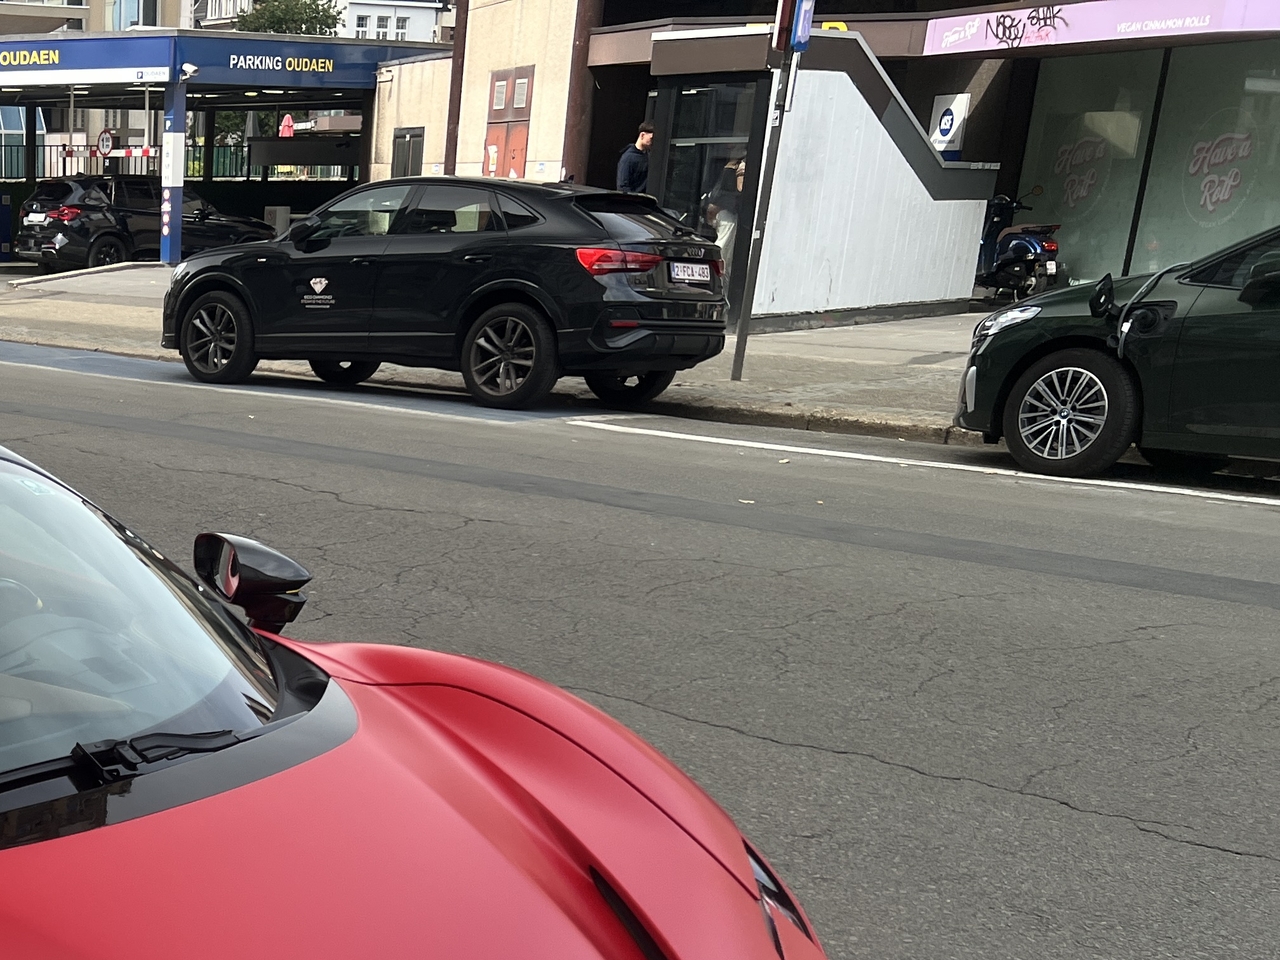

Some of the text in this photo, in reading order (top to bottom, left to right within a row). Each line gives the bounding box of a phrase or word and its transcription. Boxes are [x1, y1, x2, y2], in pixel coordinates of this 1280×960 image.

[1117, 15, 1211, 33] VEGAN CINNAMON ROLLS
[0, 50, 60, 66] OUDAEN
[229, 54, 334, 73] PARKING OUDAEN
[1188, 133, 1252, 176] Have a
[1200, 168, 1242, 213] Roll
